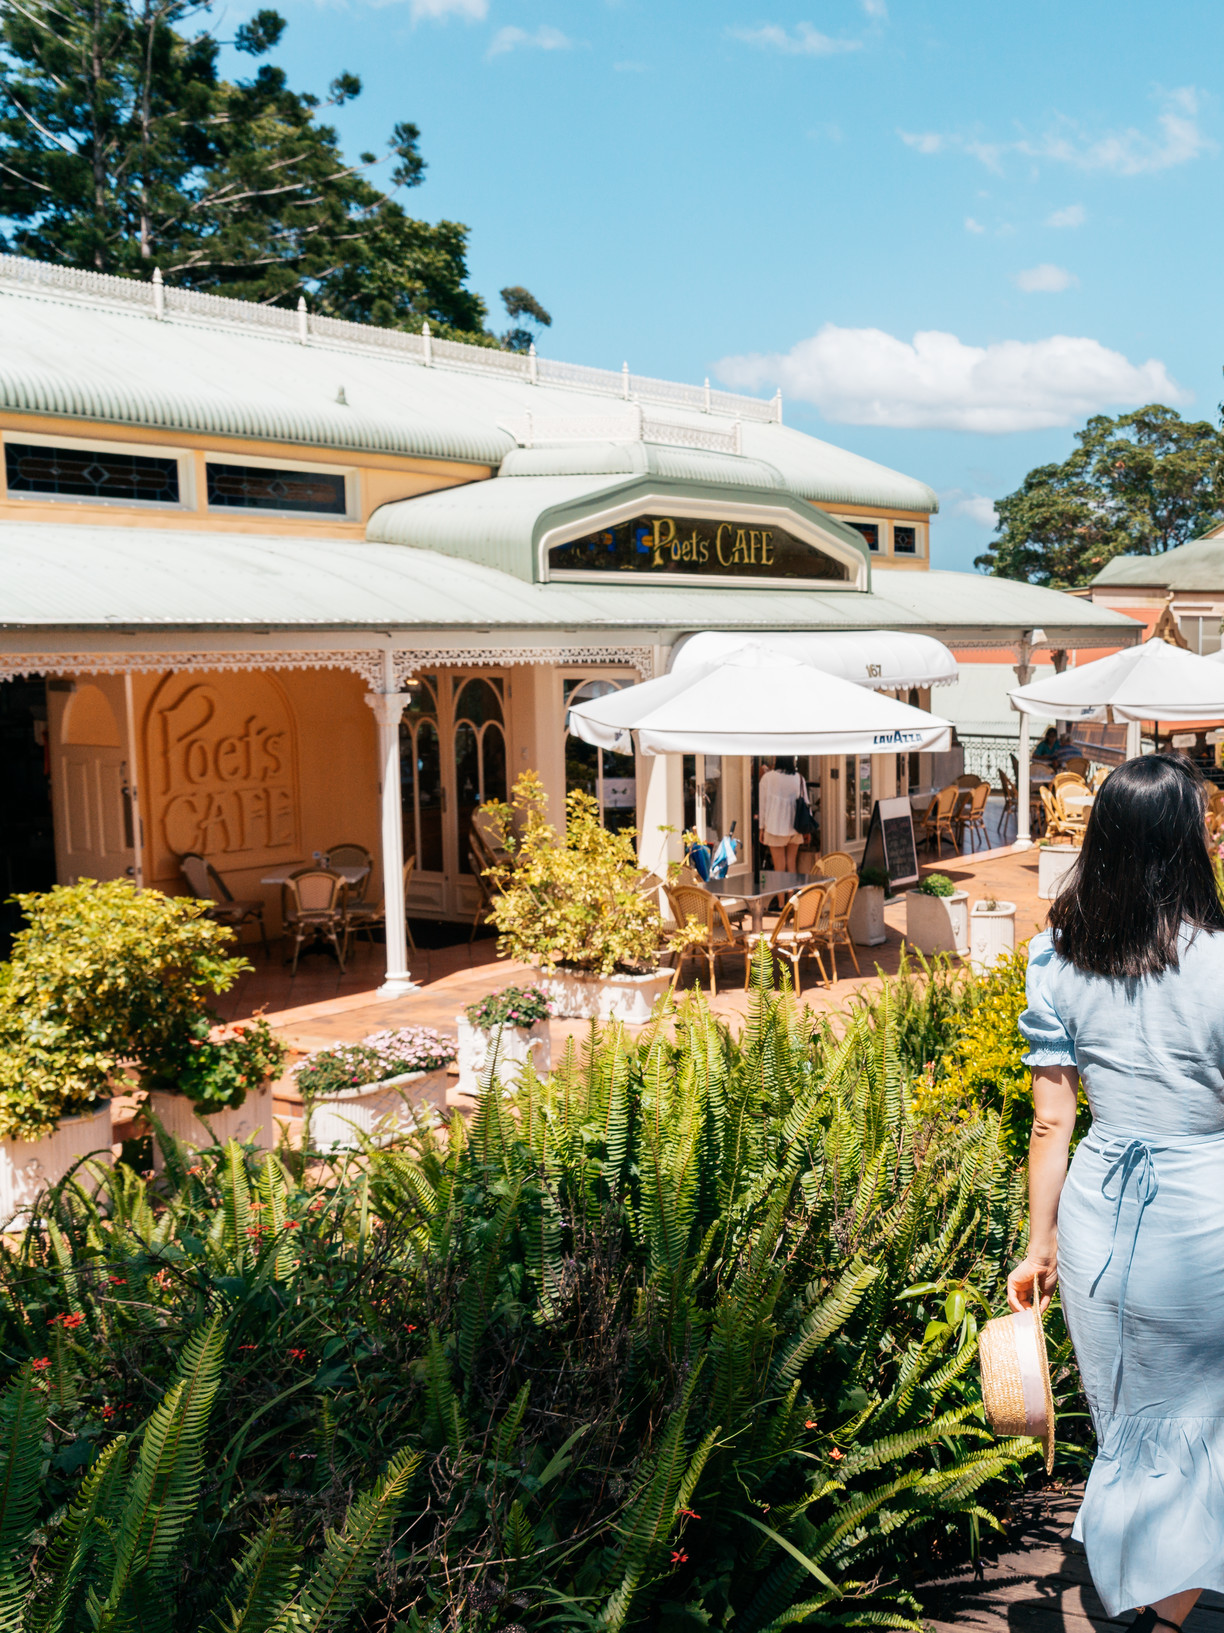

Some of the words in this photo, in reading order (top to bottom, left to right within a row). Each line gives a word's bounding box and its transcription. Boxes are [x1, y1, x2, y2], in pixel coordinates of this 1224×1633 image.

[716, 523, 774, 566] CAFE
[866, 664, 882, 678] 167
[158, 683, 286, 795] Poet's
[873, 730, 923, 744] LAVAZZA
[161, 786, 292, 857] CAFE
